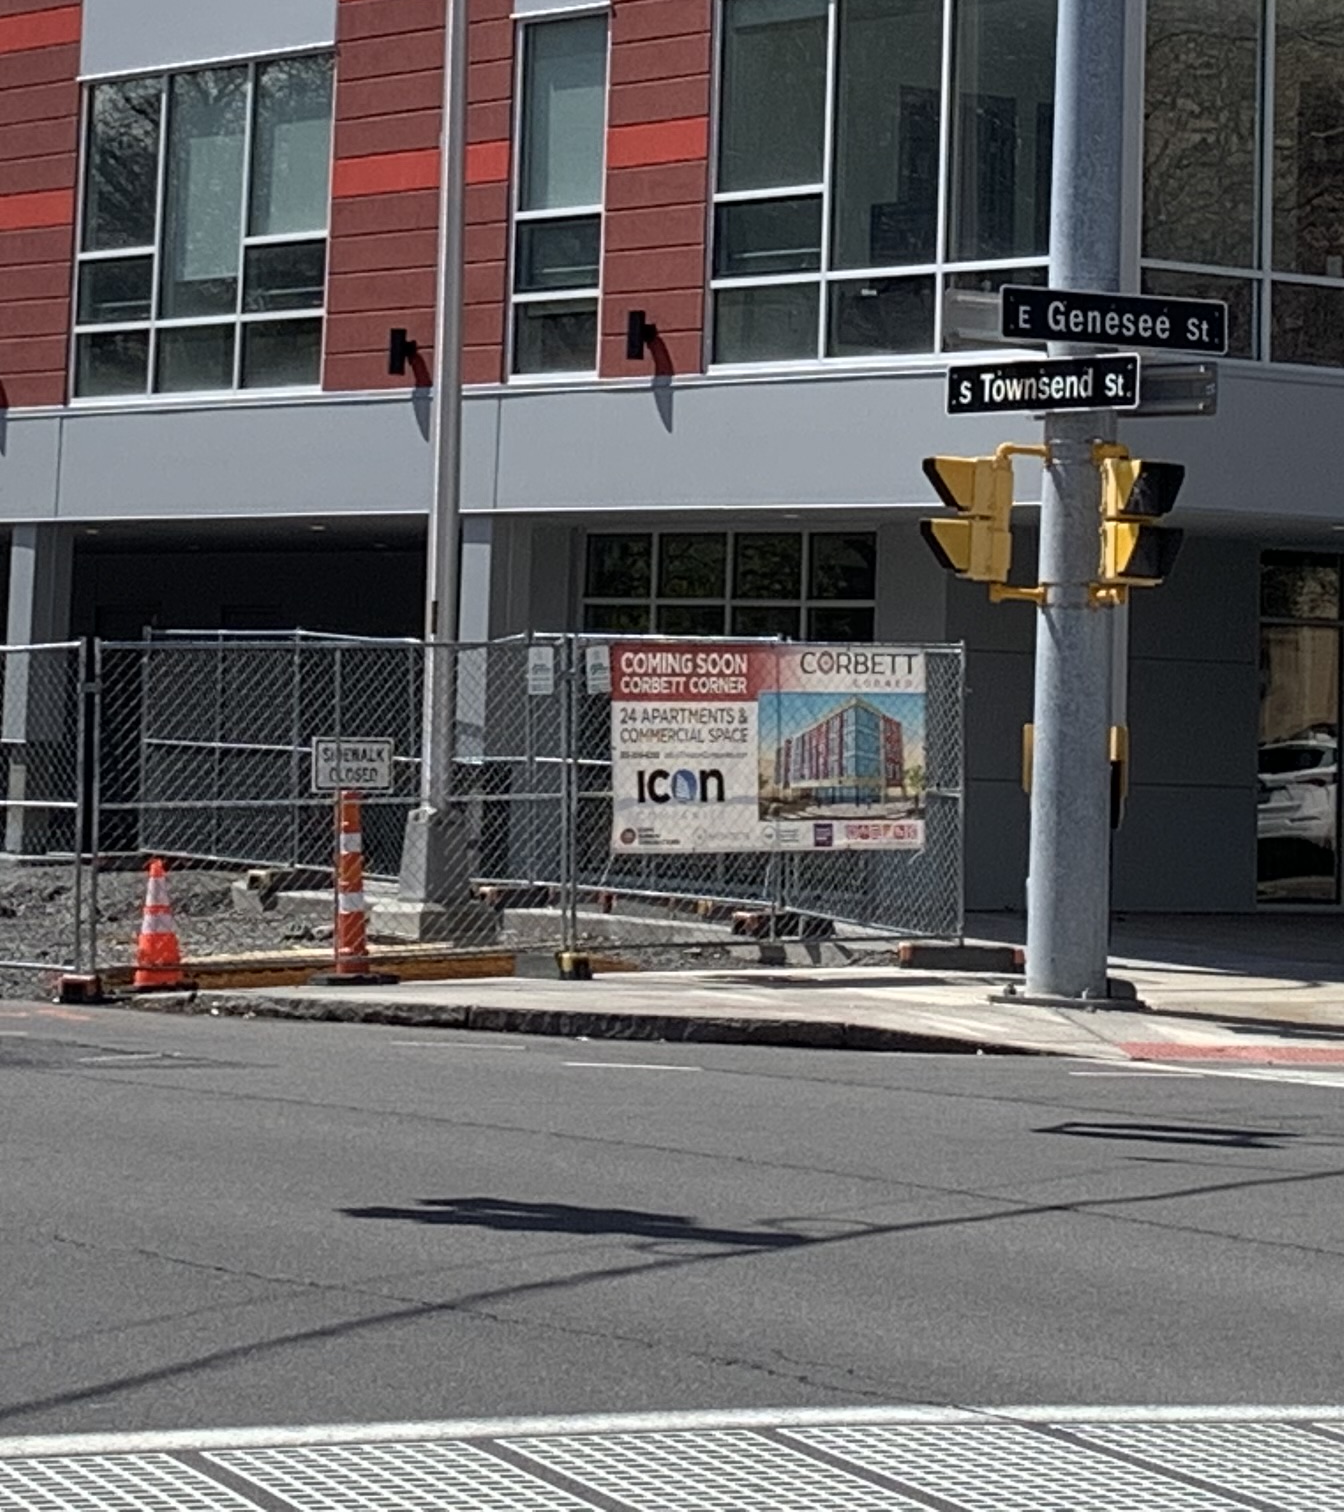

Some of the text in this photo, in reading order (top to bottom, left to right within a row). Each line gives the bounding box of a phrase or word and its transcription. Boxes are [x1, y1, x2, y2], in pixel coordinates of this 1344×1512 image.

[1018, 300, 1210, 343] E Genesee St
[959, 367, 1126, 404] S Townsend St
[621, 652, 748, 674] COMING SOON
[800, 650, 919, 675] CORBETT
[620, 676, 685, 693] CORBETT
[689, 677, 747, 693] CORNER
[620, 707, 748, 724] 24 APARTMENTS &
[620, 727, 748, 744] COMMERCIAL SPACE
[322, 746, 385, 763] SIEWALK
